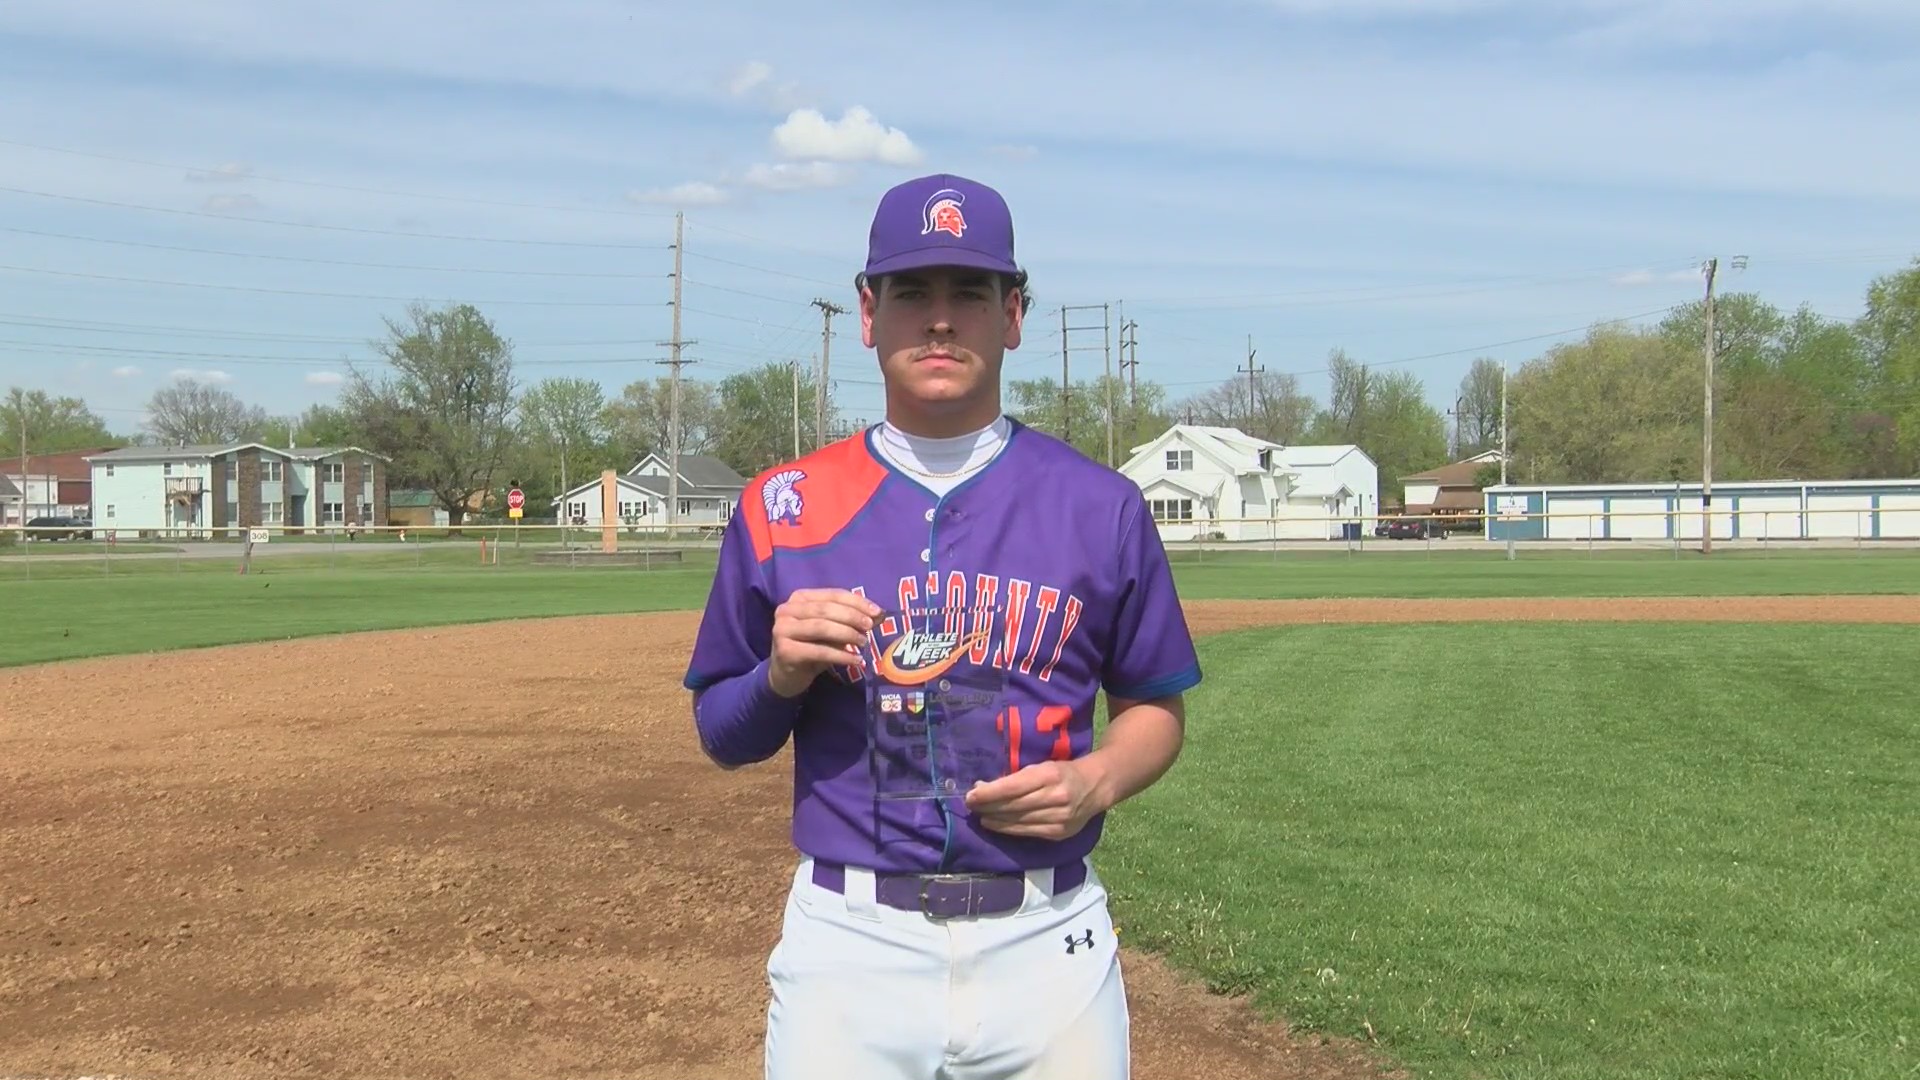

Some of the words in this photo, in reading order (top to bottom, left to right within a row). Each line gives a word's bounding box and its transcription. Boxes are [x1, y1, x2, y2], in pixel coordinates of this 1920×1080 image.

[510, 495, 524, 504] STOP
[893, 629, 959, 656] ATHLETE
[902, 642, 952, 665] WEEK
